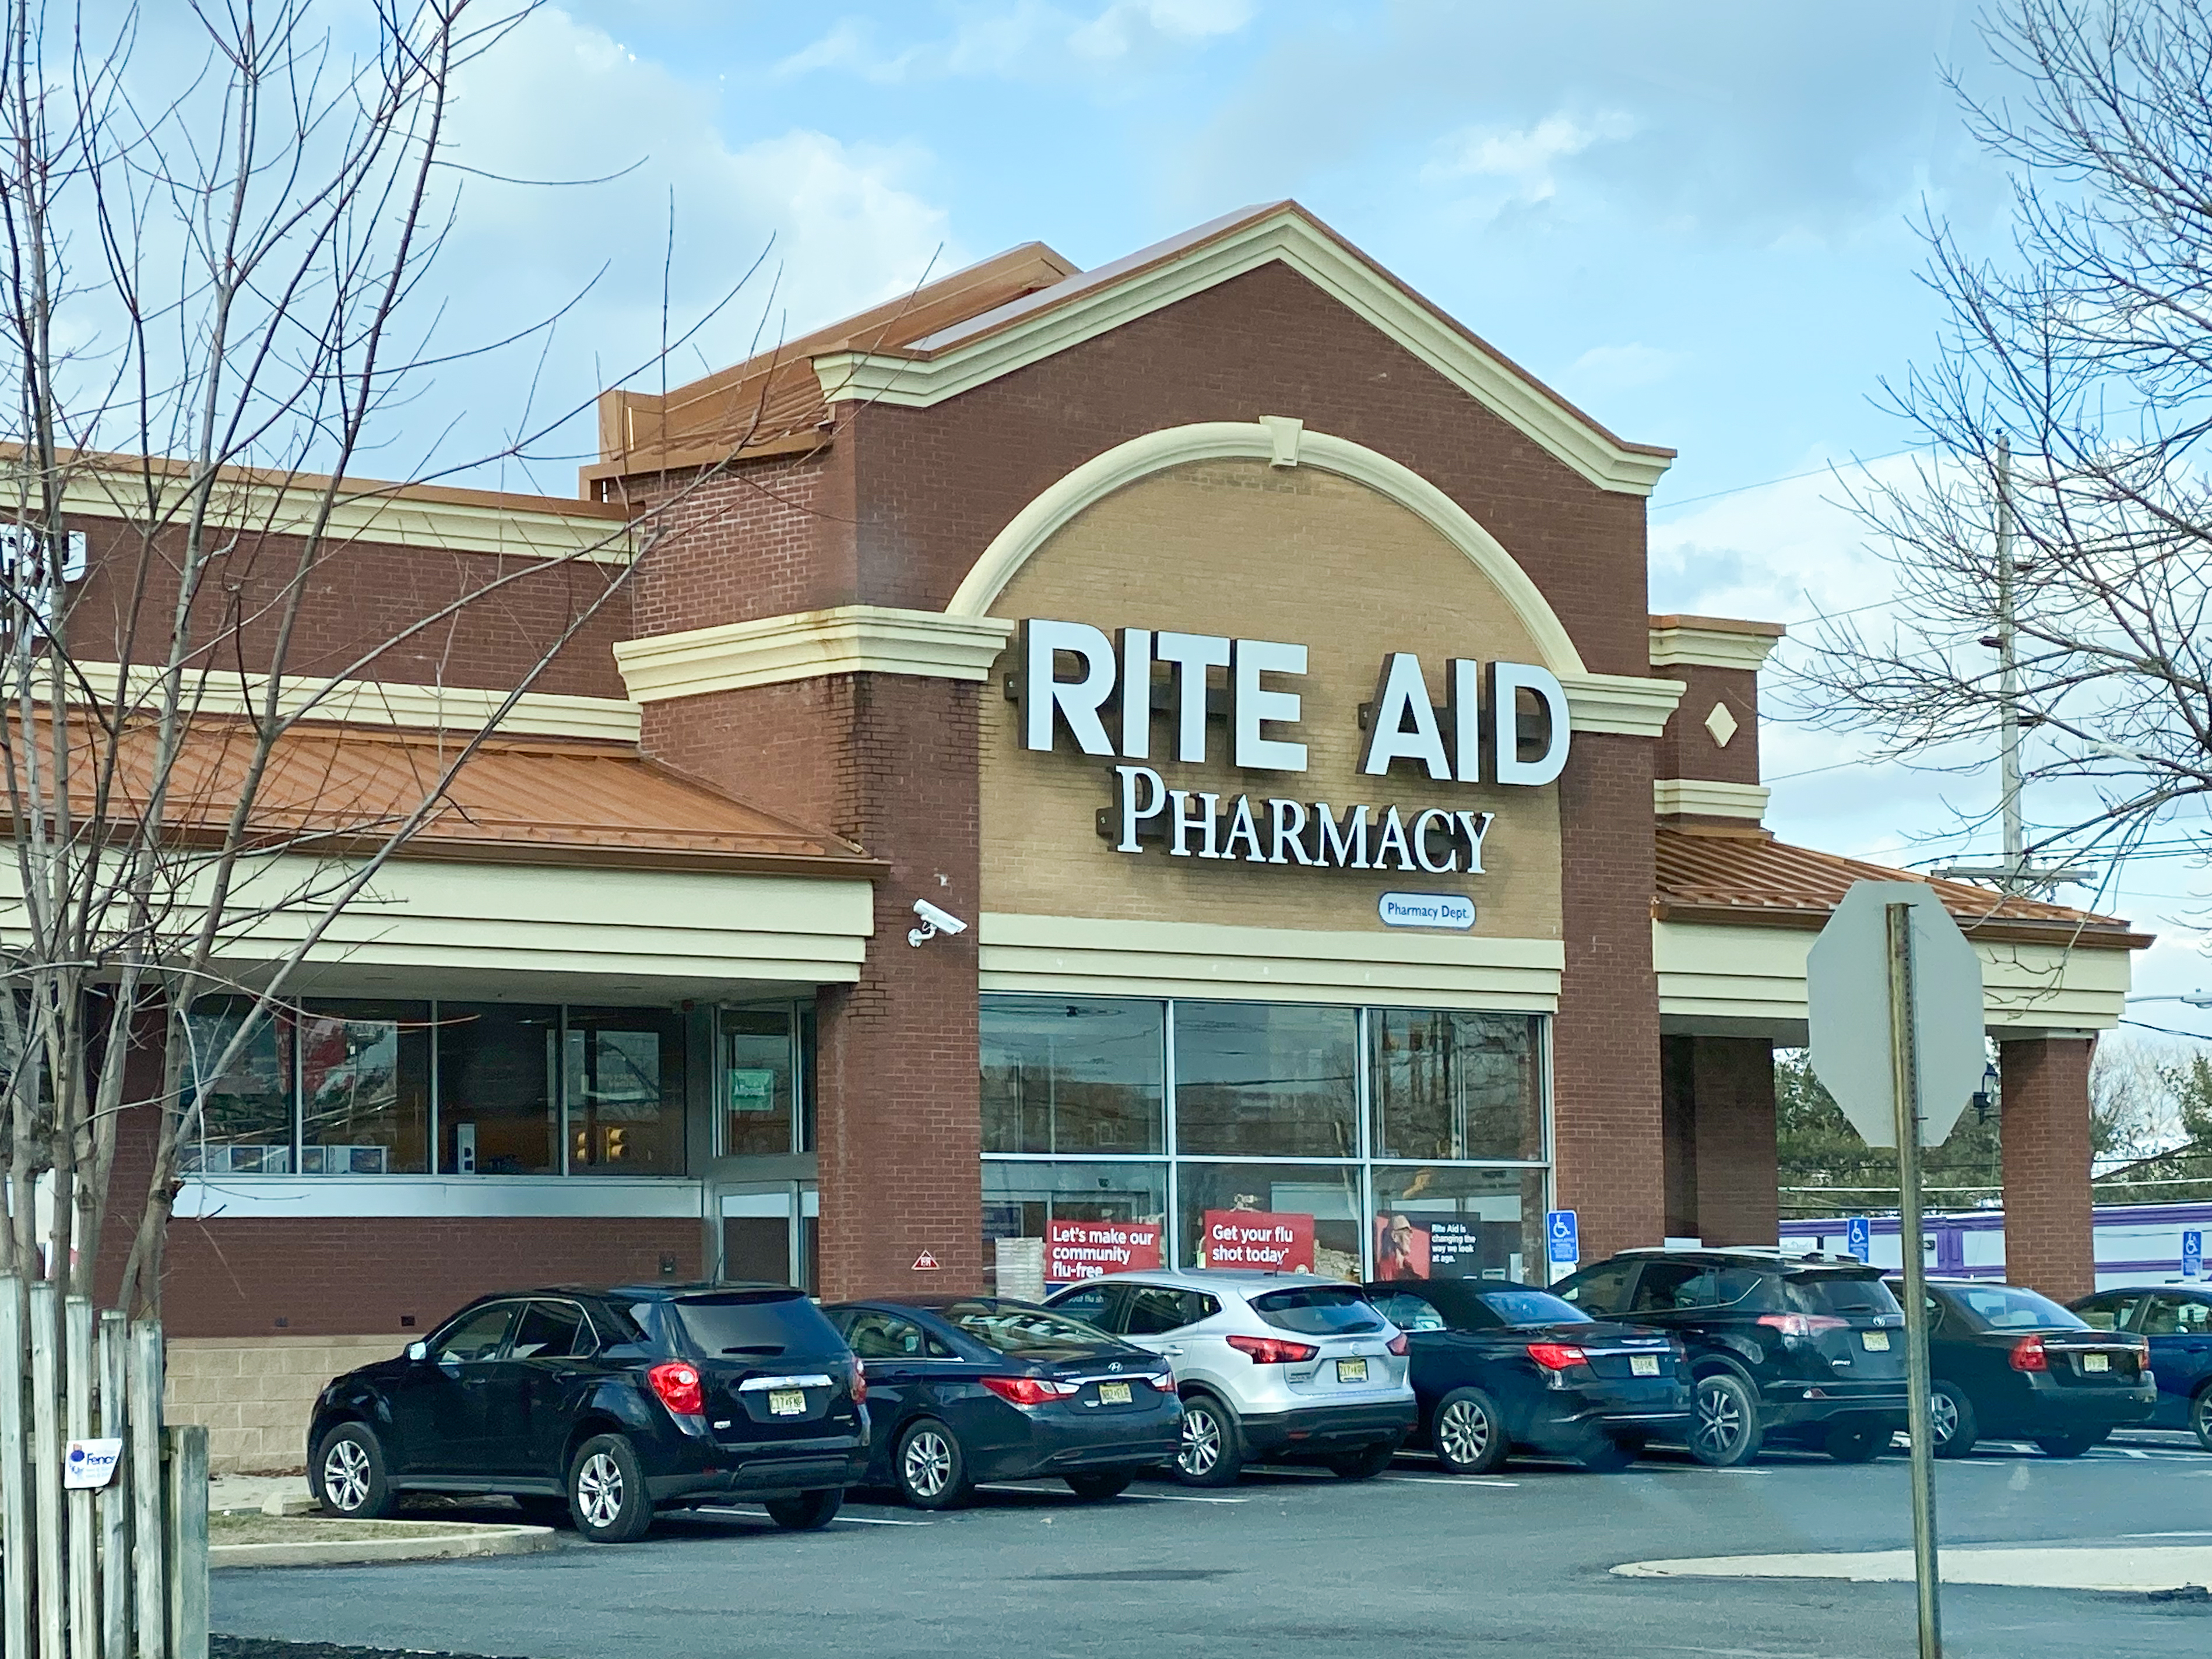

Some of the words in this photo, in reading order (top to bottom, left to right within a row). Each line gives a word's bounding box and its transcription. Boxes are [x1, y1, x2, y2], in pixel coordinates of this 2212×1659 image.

[1024, 618, 1309, 772] RITE
[1362, 651, 1571, 786] AID
[1114, 765, 1495, 874] PHARMACY
[1388, 902, 1438, 921] Pharmacy
[1441, 905, 1470, 922] Dept.
[1053, 1225, 1086, 1243] Let's
[1089, 1228, 1127, 1245] make
[1129, 1232, 1154, 1245] our
[1212, 1224, 1238, 1241] Get
[1240, 1228, 1272, 1245] your
[1274, 1225, 1293, 1243] flu
[1446, 1224, 1459, 1233] Aid
[1432, 1233, 1464, 1245] changing
[1464, 1234, 1476, 1243] the
[1458, 1244, 1475, 1253] look
[1052, 1246, 1131, 1266] community
[1212, 1243, 1243, 1261] shot
[1052, 1261, 1104, 1278] flu-free
